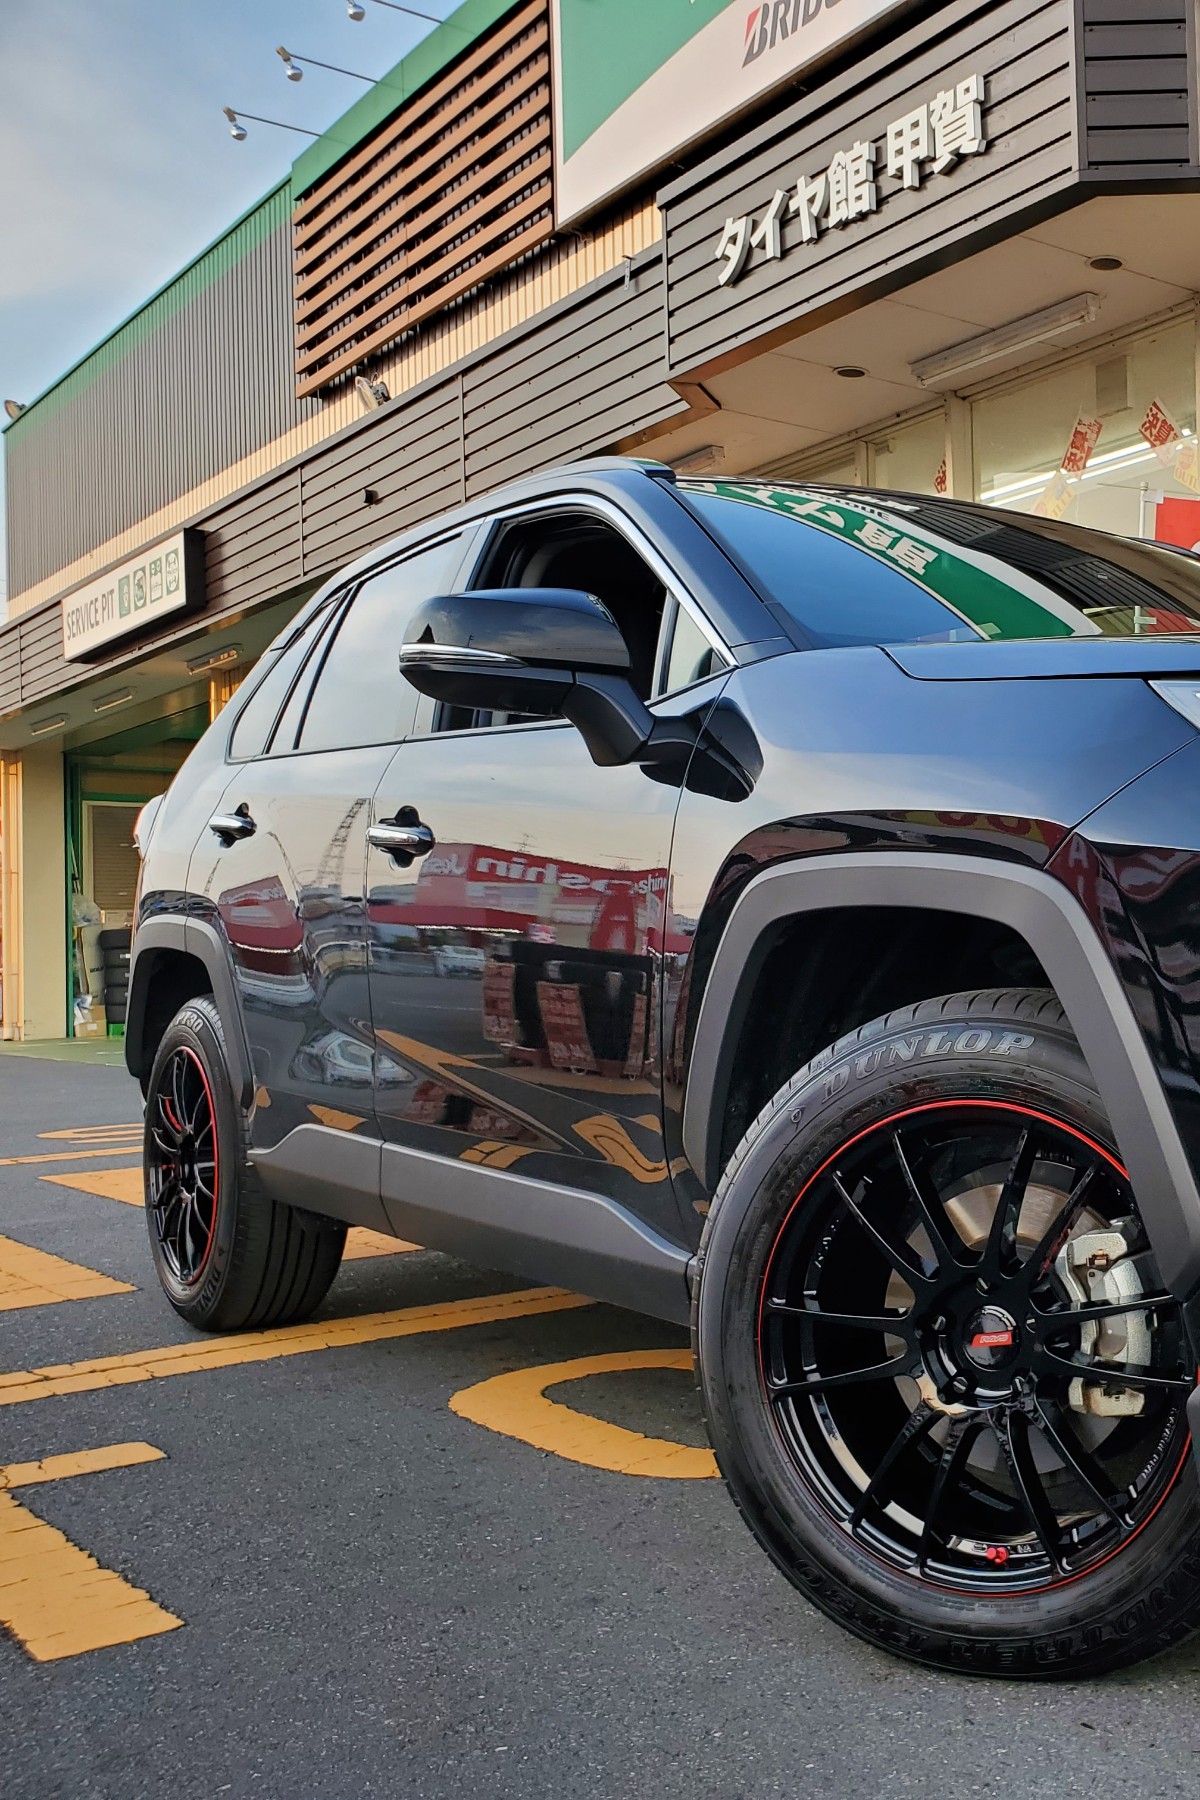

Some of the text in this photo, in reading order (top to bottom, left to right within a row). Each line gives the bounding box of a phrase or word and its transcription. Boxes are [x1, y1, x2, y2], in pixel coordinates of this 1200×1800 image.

[742, 0, 848, 68] BRI
[715, 73, 986, 287] タイヤ館 甲賀
[66, 588, 115, 641] SERVICE PIT
[820, 1029, 1035, 1104] DUNLOP
